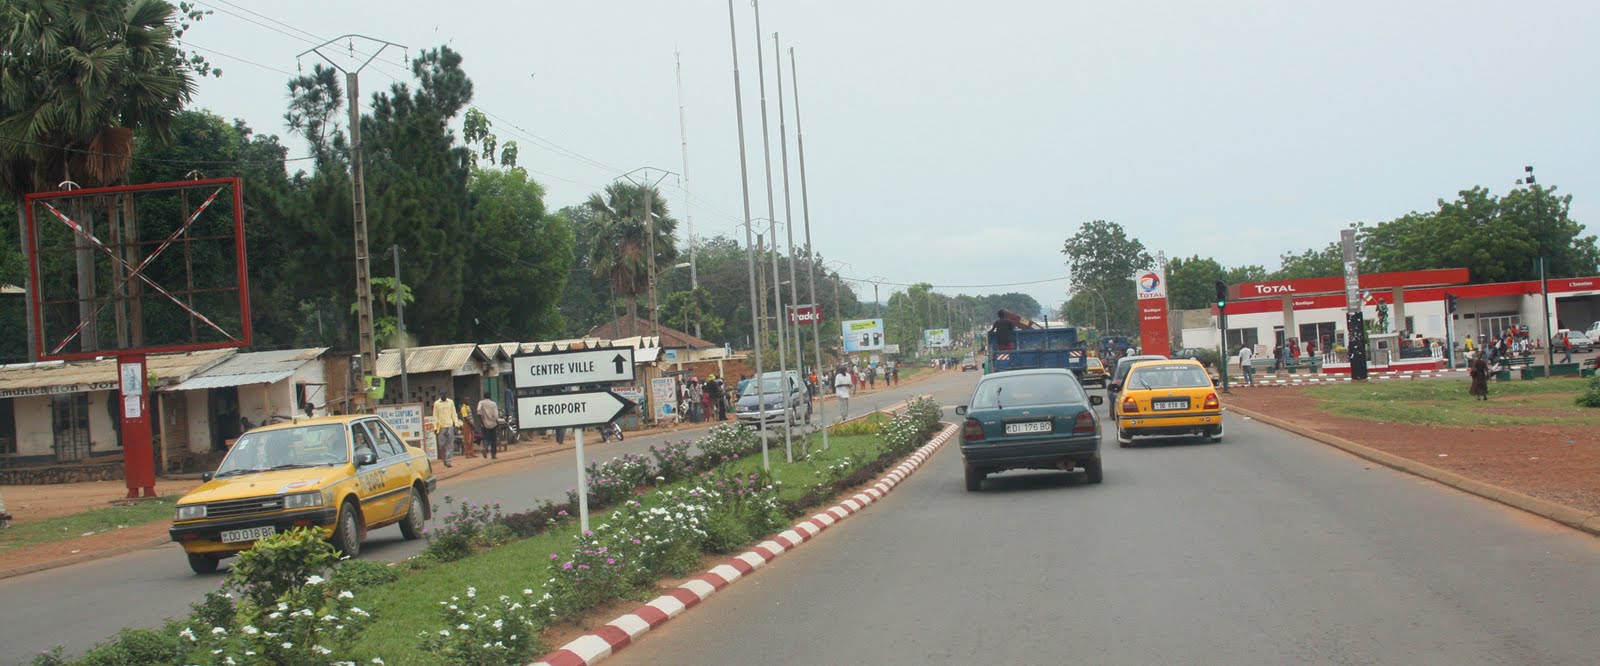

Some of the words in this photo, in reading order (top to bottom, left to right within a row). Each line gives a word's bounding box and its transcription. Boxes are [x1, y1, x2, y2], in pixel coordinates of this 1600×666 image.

[1255, 284, 1296, 294] TOTAL
[530, 363, 564, 376] CENTRE
[568, 361, 594, 373] VILLE
[534, 402, 587, 416] AEROPORT
[1024, 423, 1038, 431] 176
[1040, 422, 1051, 431] BG
[242, 529, 260, 540] 018
